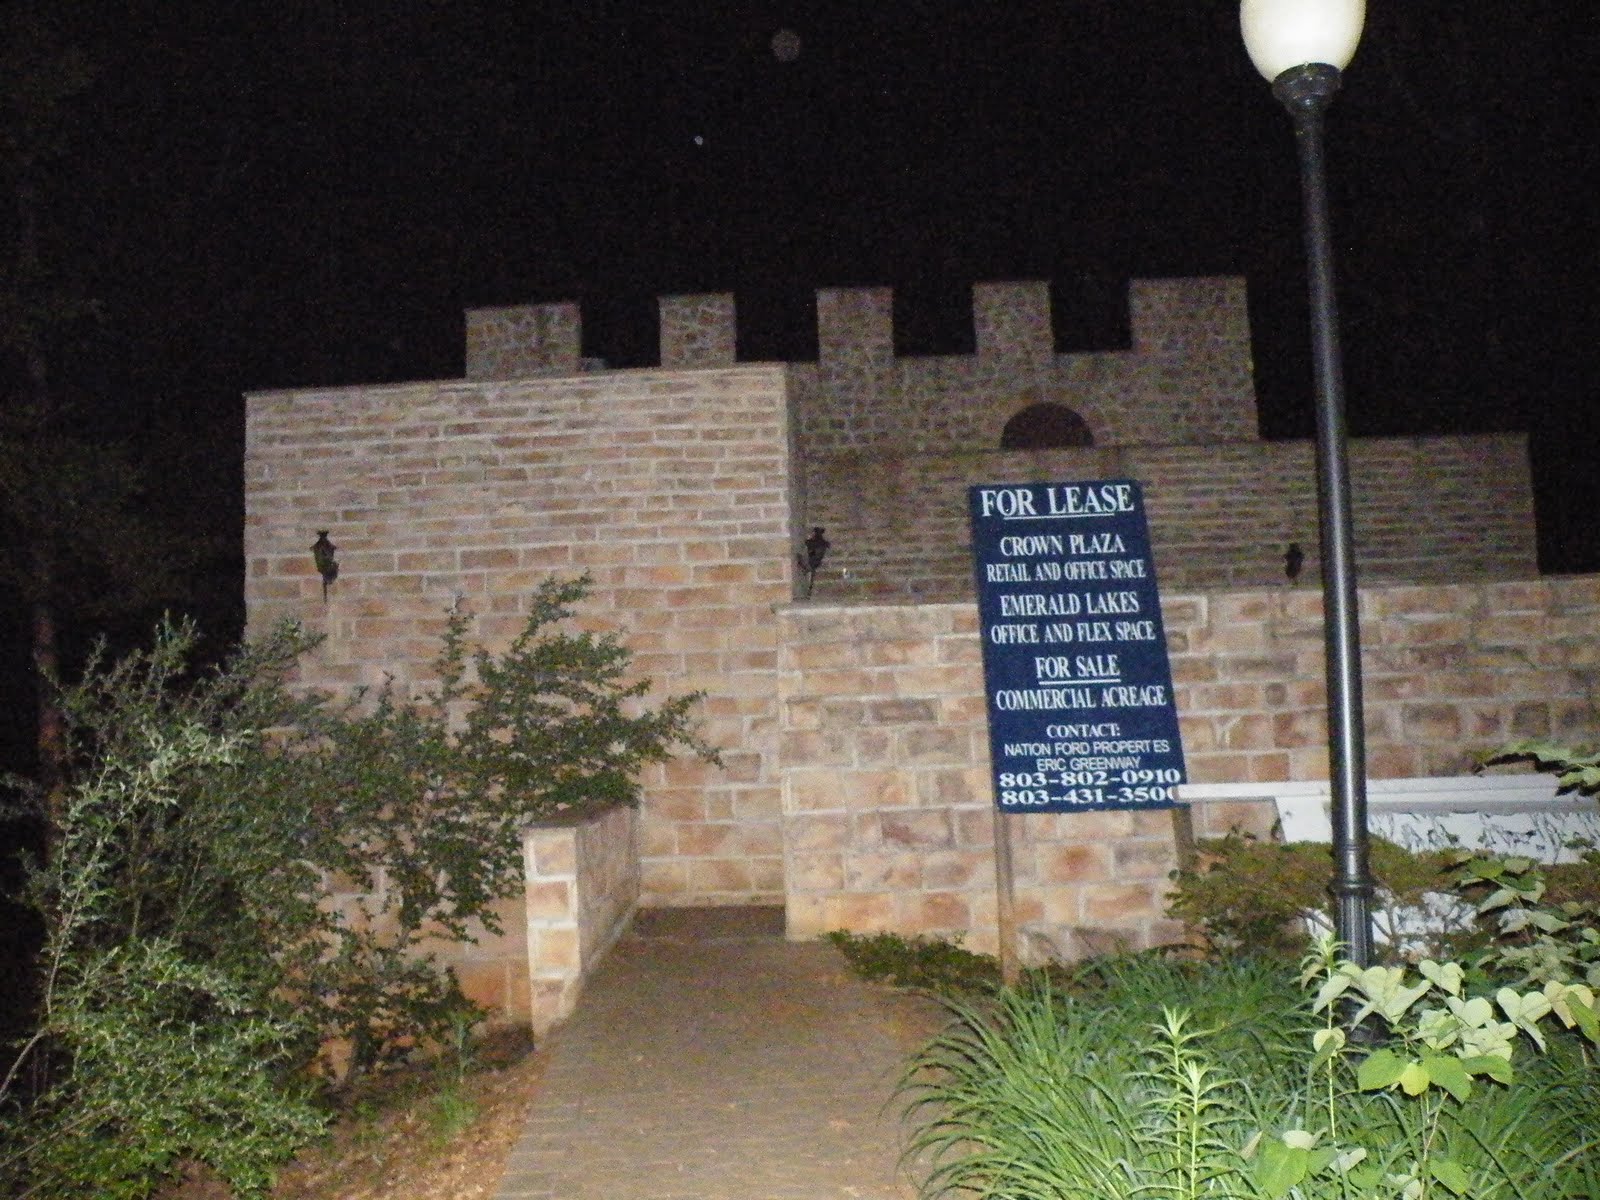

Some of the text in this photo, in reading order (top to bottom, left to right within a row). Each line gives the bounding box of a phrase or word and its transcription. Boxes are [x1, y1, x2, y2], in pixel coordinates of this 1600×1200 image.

[981, 485, 1134, 516] FOR LEASE
[1000, 533, 1126, 556] CROWN PLAZA
[987, 559, 1146, 582] RETAIL AND OFFICE SPACE
[1000, 591, 1139, 616] EMERALD LAKES
[991, 621, 1155, 644] OFFICE AND FLEX SPACE
[1035, 655, 1120, 678] FOR SALE
[996, 686, 1167, 710] COMMERCIAL ACREAGE
[1046, 723, 1120, 739] CONTACT:
[1005, 743, 1050, 757] NATION
[1055, 742, 1089, 756] FORD
[1037, 757, 1141, 772] ERIC GREENWAY
[999, 769, 1181, 787] 803-802-0910
